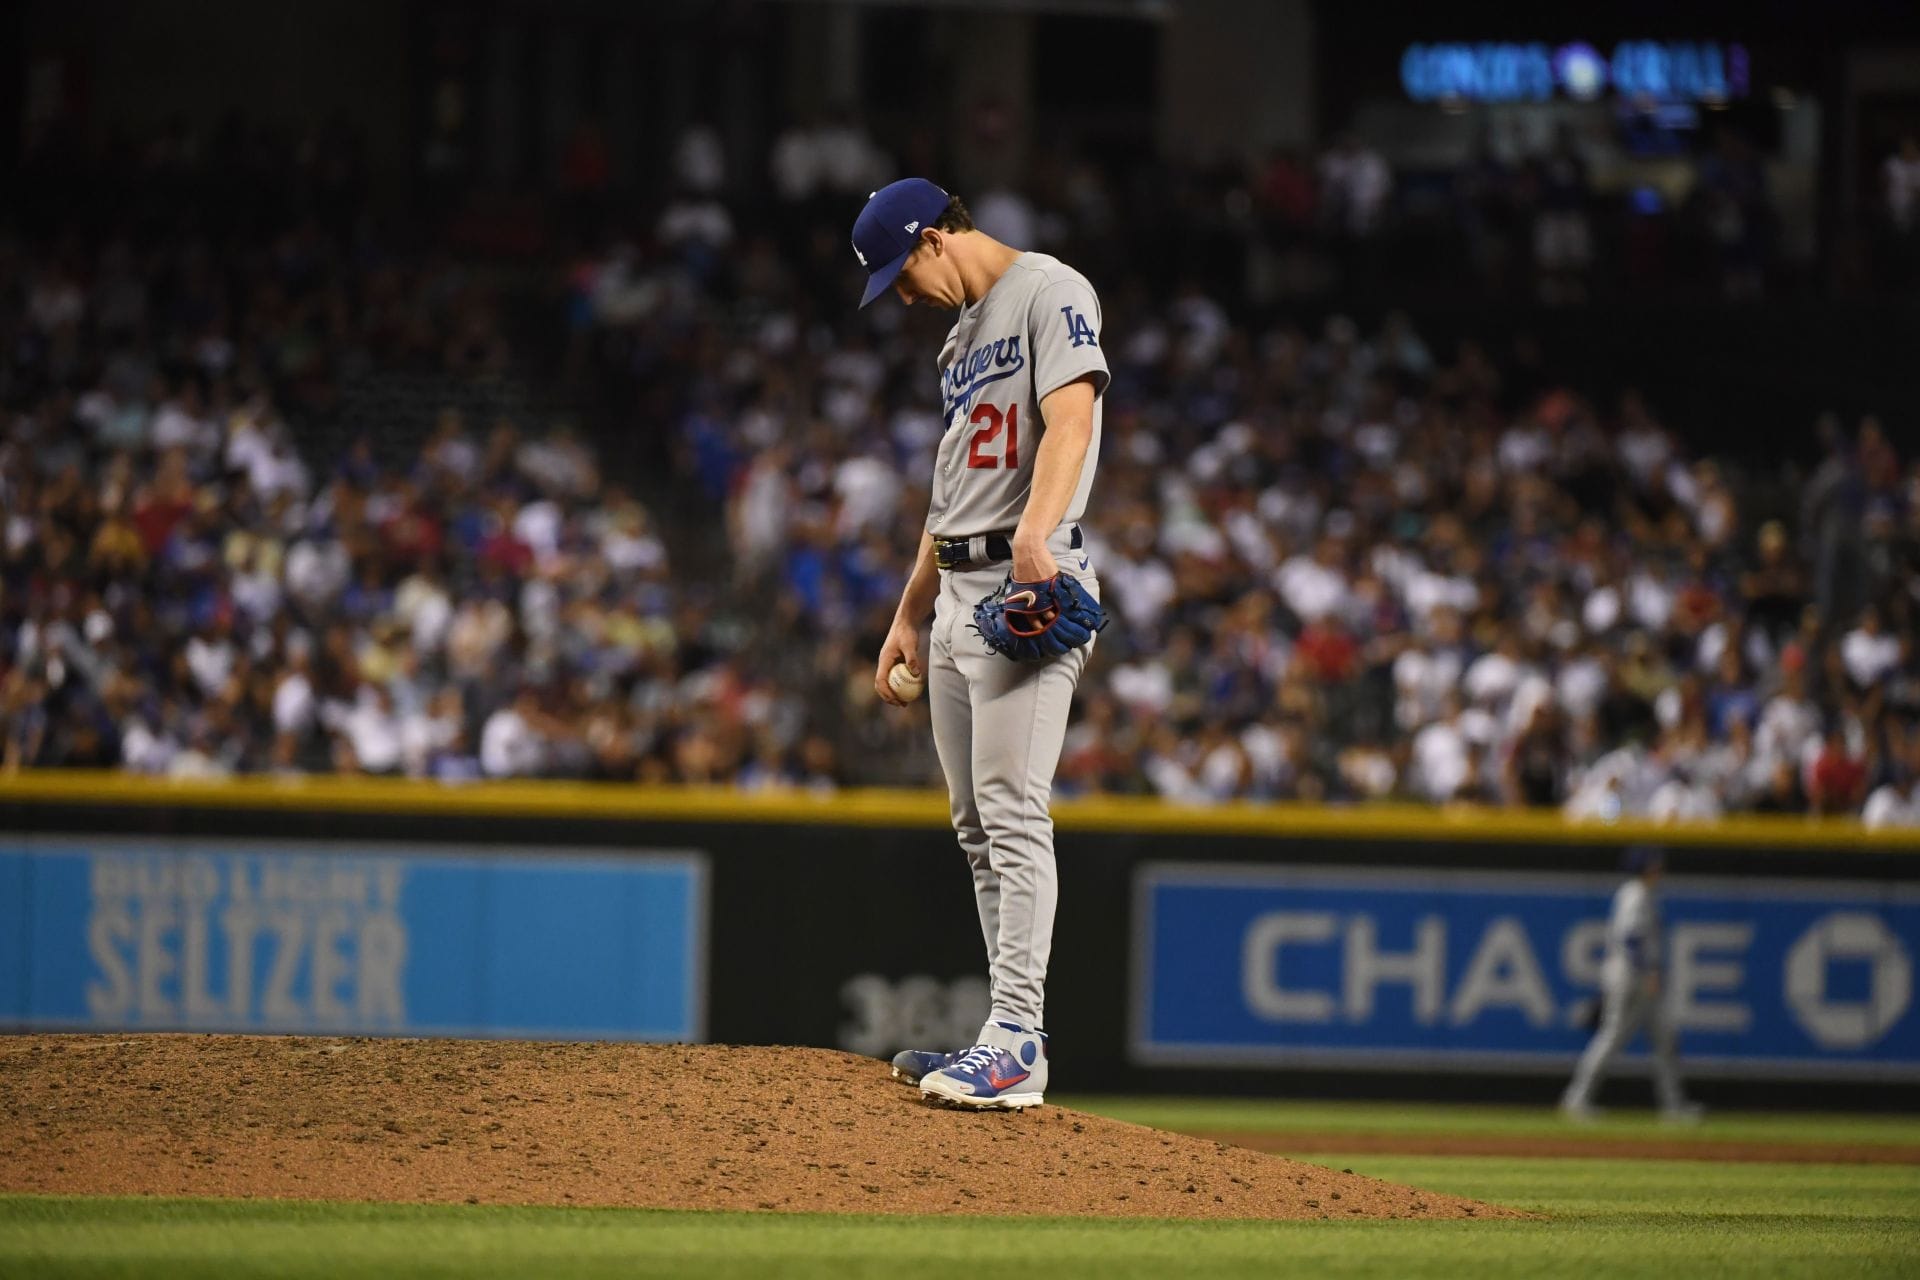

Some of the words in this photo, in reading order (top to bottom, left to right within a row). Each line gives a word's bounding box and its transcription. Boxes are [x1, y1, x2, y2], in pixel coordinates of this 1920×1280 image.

[1061, 305, 1098, 348] LA
[942, 335, 1024, 420] odgers
[967, 403, 1019, 469] 21
[88, 906, 408, 1022] SELTZER
